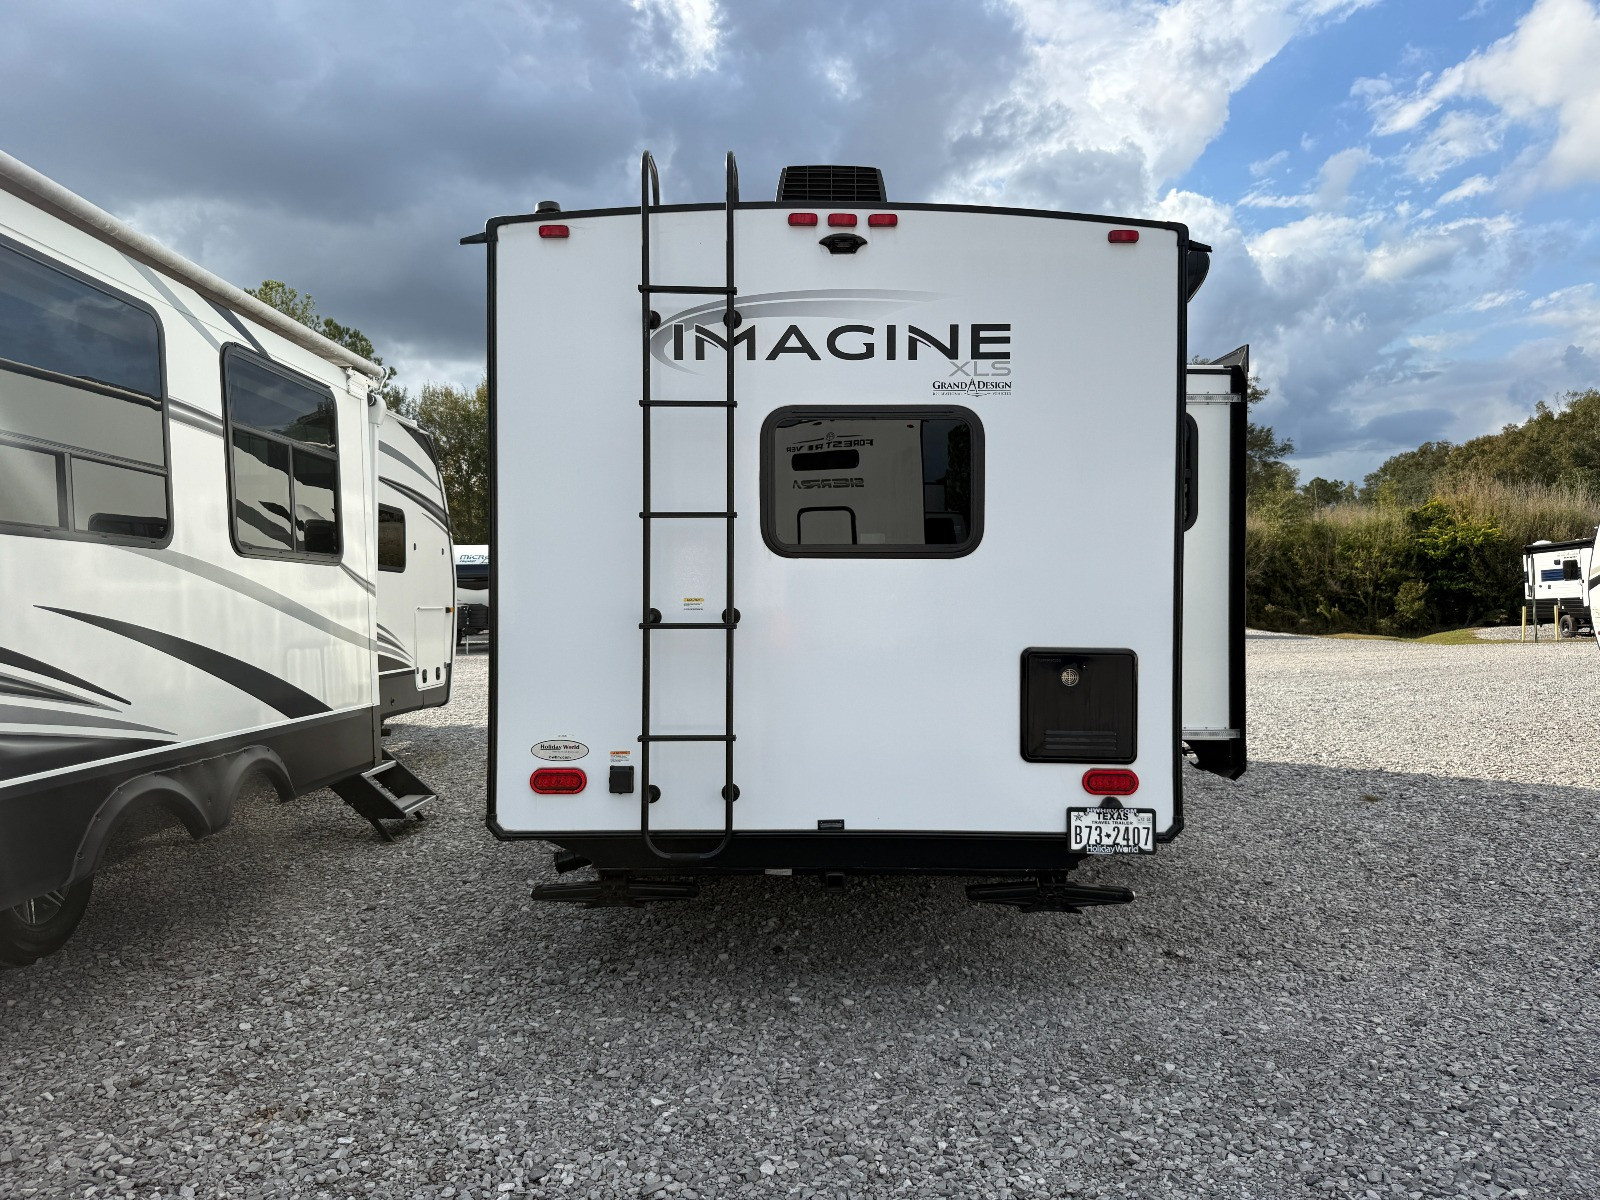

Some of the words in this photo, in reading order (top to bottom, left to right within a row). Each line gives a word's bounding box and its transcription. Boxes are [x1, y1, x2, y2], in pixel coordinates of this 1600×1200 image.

[673, 323, 1011, 361] IMAGINE
[949, 361, 1011, 377] XLS
[932, 381, 967, 389] GRAND
[977, 381, 1012, 389] DESIGN
[1097, 812, 1129, 820] TEXAS
